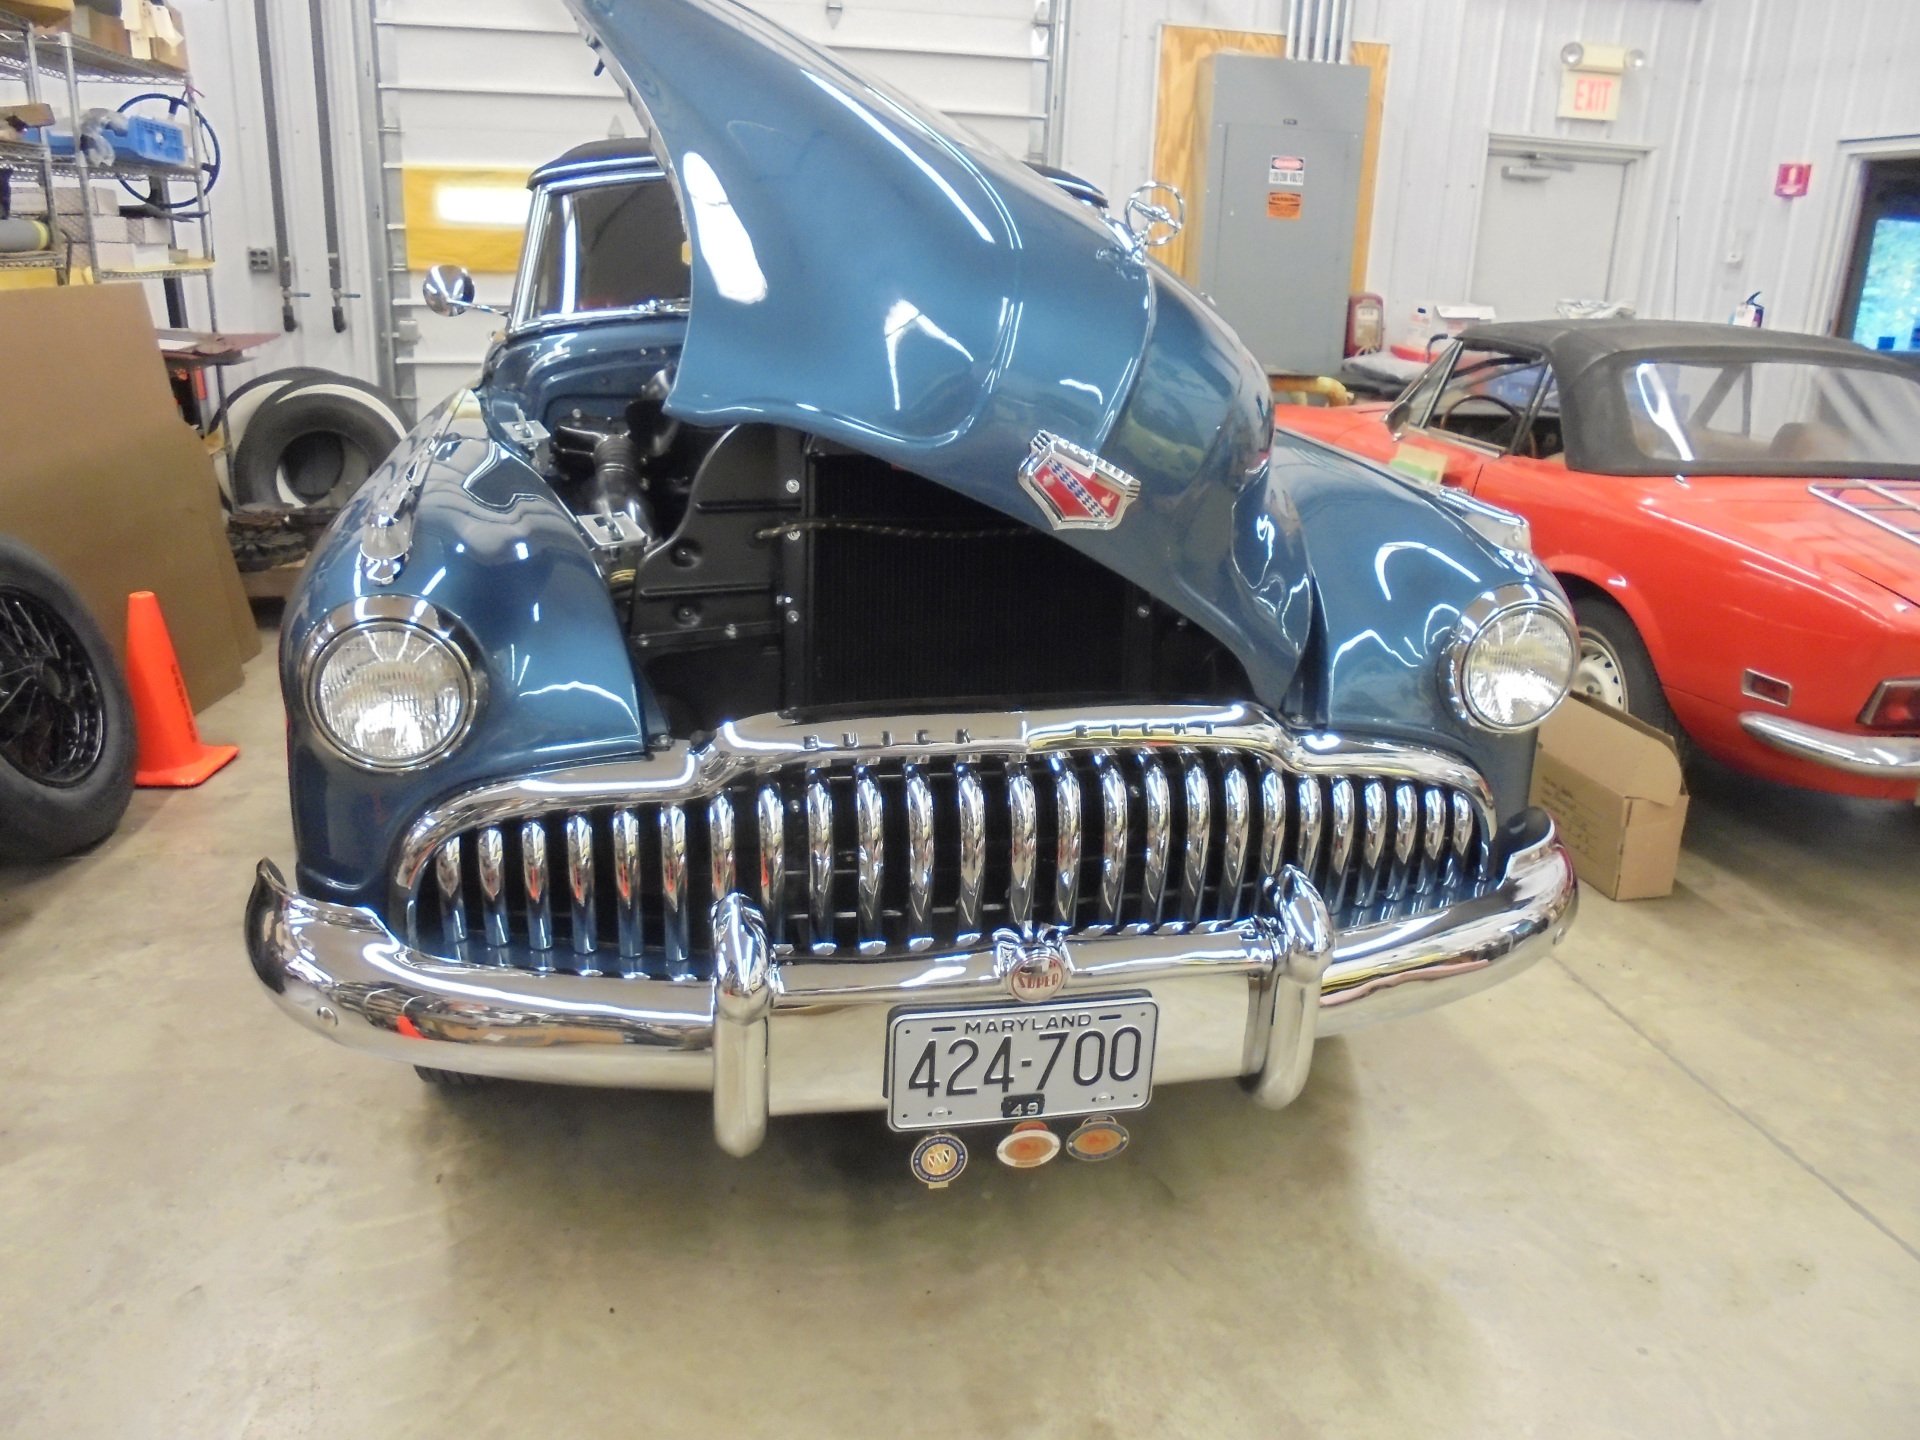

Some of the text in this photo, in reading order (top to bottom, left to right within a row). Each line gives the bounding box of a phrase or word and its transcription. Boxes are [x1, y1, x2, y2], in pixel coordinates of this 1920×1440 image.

[1574, 78, 1614, 112] EXIT
[803, 728, 971, 749] BUICK
[1075, 723, 1214, 738] EIGHT
[1018, 974, 1059, 988] SUPER
[964, 1014, 1091, 1034] MARYLAND
[908, 1026, 1142, 1097] 424-700
[1010, 1102, 1039, 1115] 49
